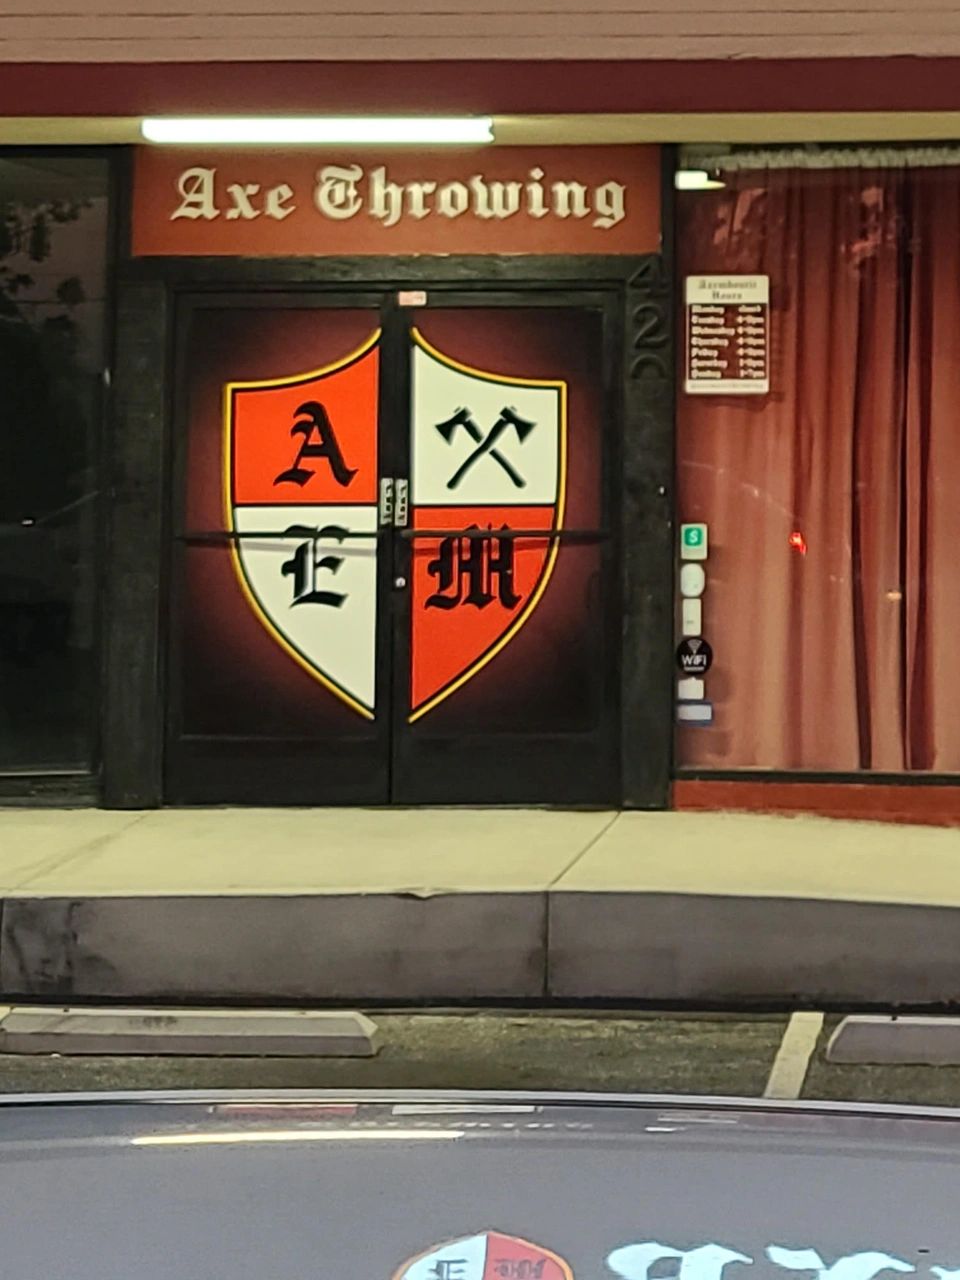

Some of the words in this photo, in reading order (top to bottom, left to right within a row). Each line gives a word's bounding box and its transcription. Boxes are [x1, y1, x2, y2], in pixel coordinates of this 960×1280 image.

[170, 166, 296, 221] Axe
[314, 164, 627, 228] Throwing
[273, 400, 359, 487] A
[280, 524, 350, 609] E
[424, 523, 523, 610] M
